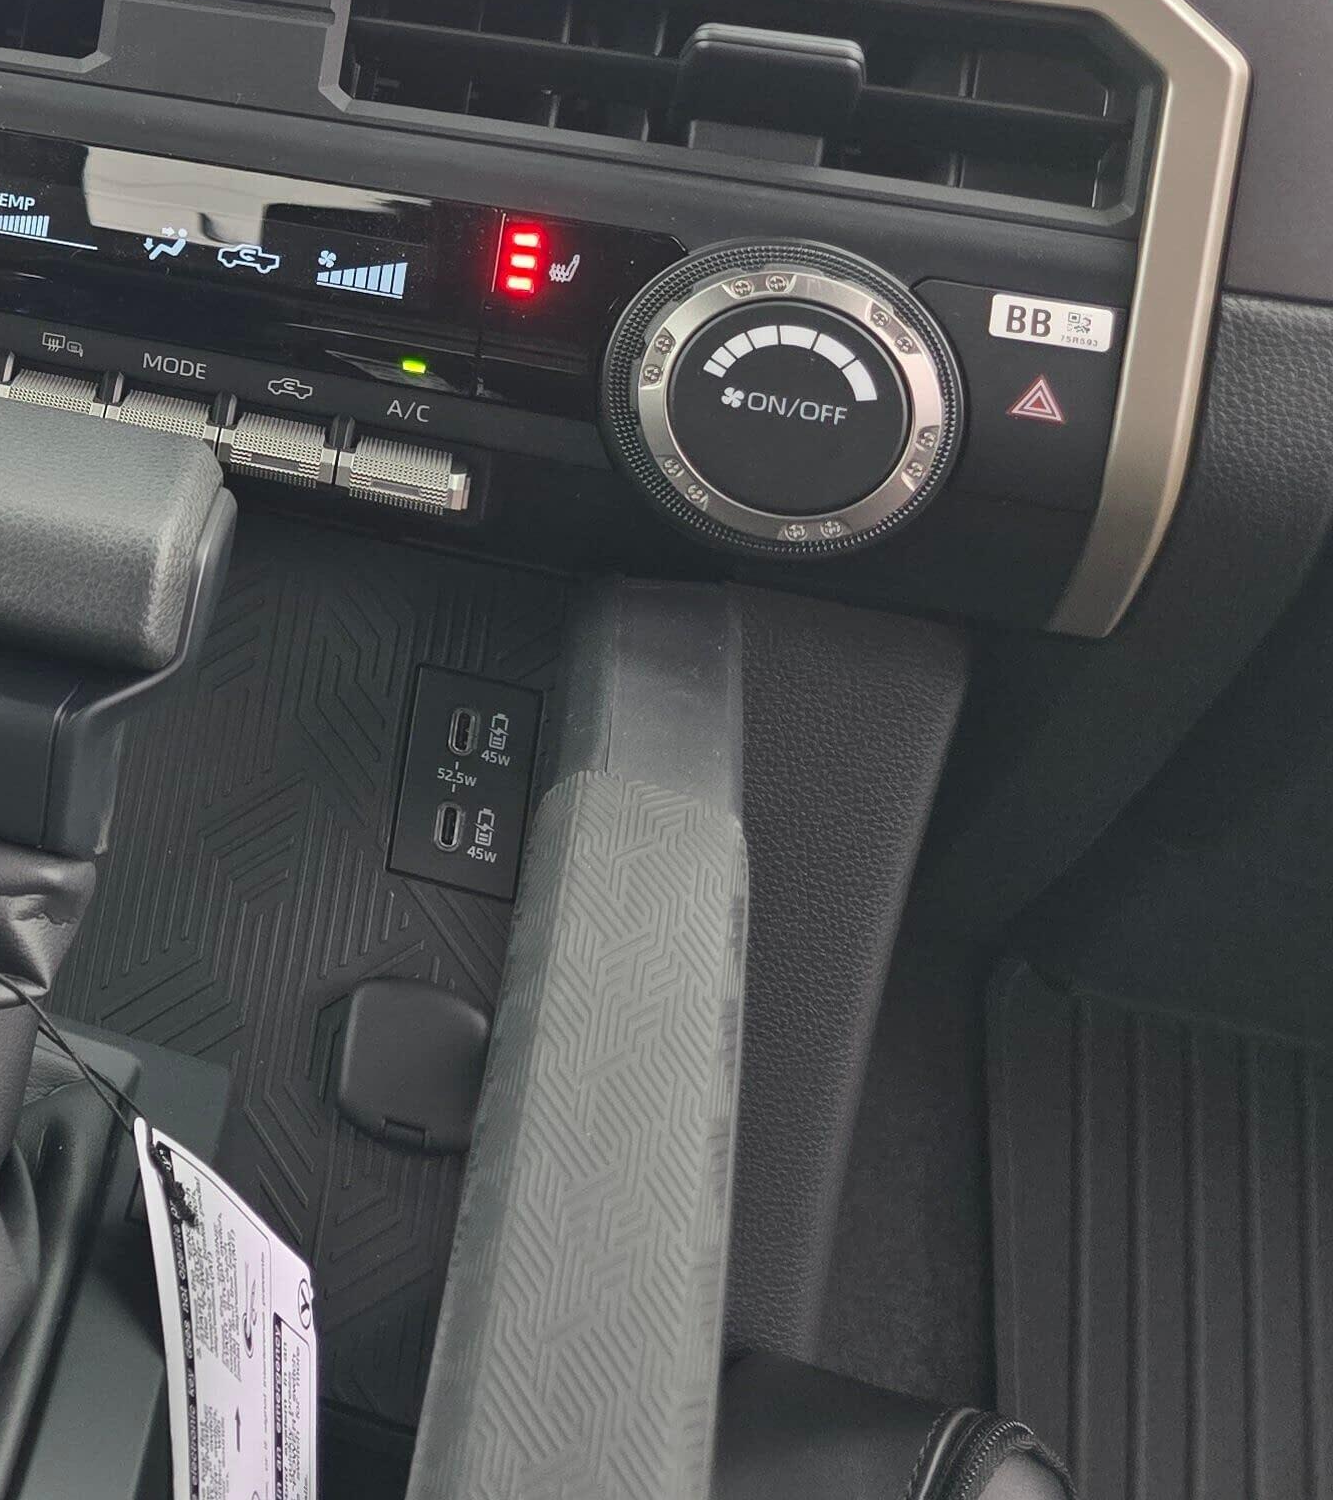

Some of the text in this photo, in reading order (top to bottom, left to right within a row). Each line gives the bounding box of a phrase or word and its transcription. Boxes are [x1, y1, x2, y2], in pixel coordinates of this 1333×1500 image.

[1005, 304, 1052, 338] BB
[142, 352, 207, 380] MODE
[386, 399, 431, 423] A/C
[746, 391, 849, 428] ON/OFF
[480, 750, 511, 766] 45W
[437, 768, 477, 787] 52.5W
[466, 846, 497, 863] 45W
